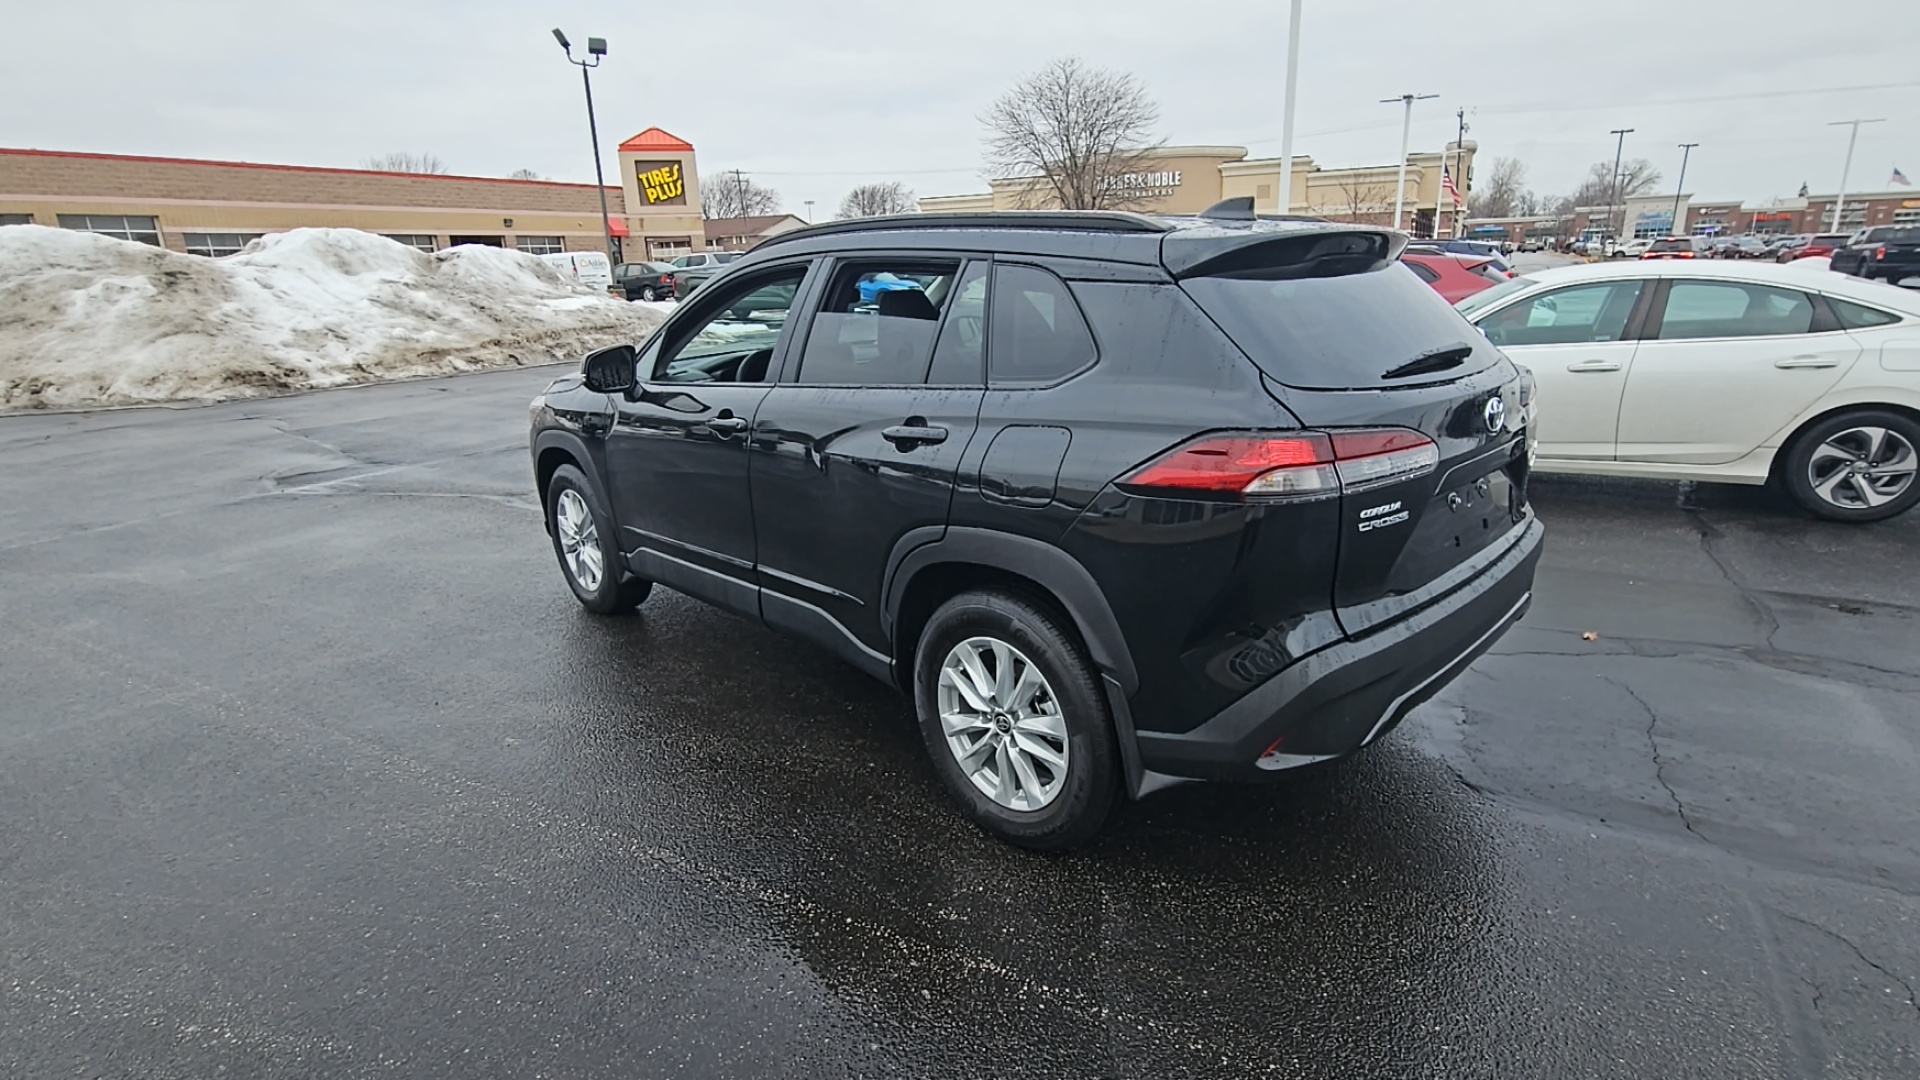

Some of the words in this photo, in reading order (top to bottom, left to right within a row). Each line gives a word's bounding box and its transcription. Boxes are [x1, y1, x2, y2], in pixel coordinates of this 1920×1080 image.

[639, 164, 679, 188] TIRES
[646, 180, 682, 203] PLUS
[1360, 501, 1401, 518] COROLLA
[1358, 511, 1409, 532] CROSS
